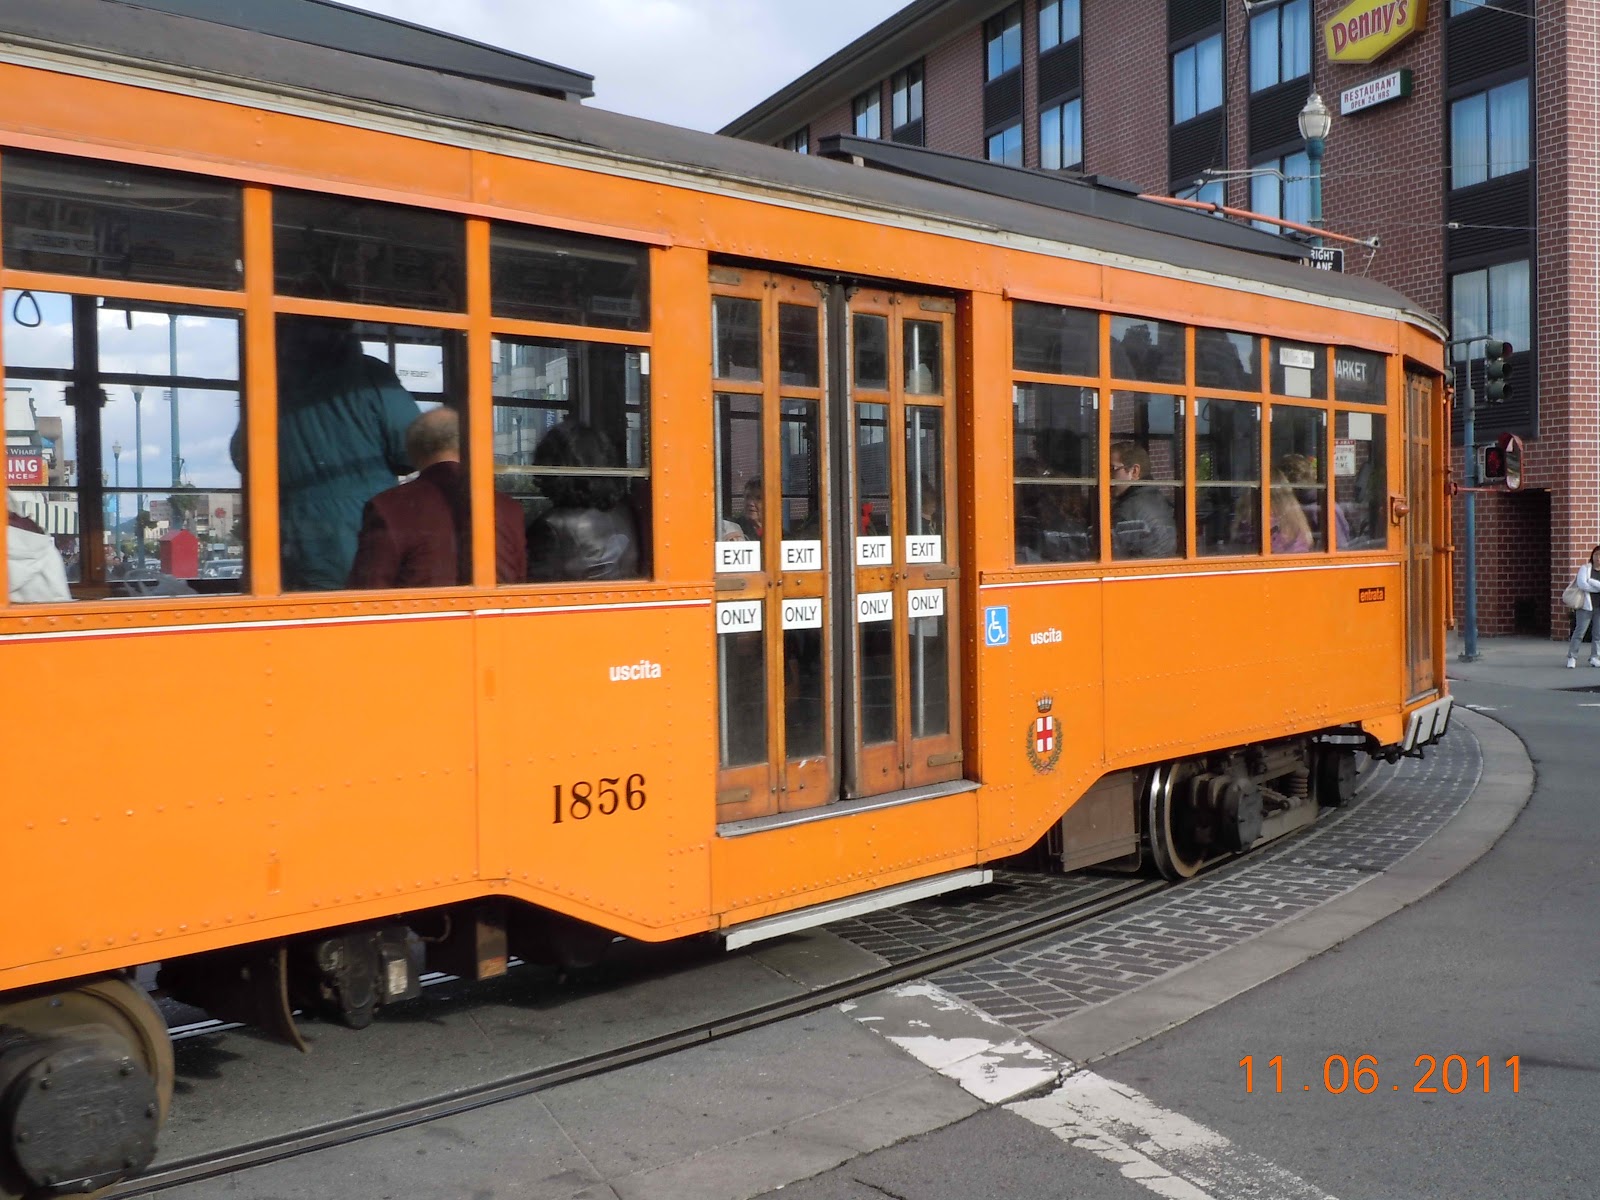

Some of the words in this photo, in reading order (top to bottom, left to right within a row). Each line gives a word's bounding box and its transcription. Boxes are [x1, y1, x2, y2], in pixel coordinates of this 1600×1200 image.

[1344, 76, 1396, 103] RESTAURANT
[1350, 98, 1365, 109] OPEN
[1368, 95, 1375, 103] 24
[1377, 89, 1390, 100] HRS
[1311, 250, 1334, 260] RIGHT
[1334, 359, 1367, 381] ARKET
[723, 549, 753, 565] EXIT
[787, 548, 815, 563] EXIT
[862, 543, 886, 558] EXIT
[911, 542, 936, 557] EXIT
[911, 595, 940, 611] ONLY
[1360, 589, 1384, 602] entrata
[784, 606, 818, 622] ONLY
[860, 599, 889, 615] ONLY
[721, 608, 757, 626] ONLY
[1030, 628, 1062, 645] uscita
[609, 660, 661, 681] uscita
[552, 773, 646, 824] 1856
